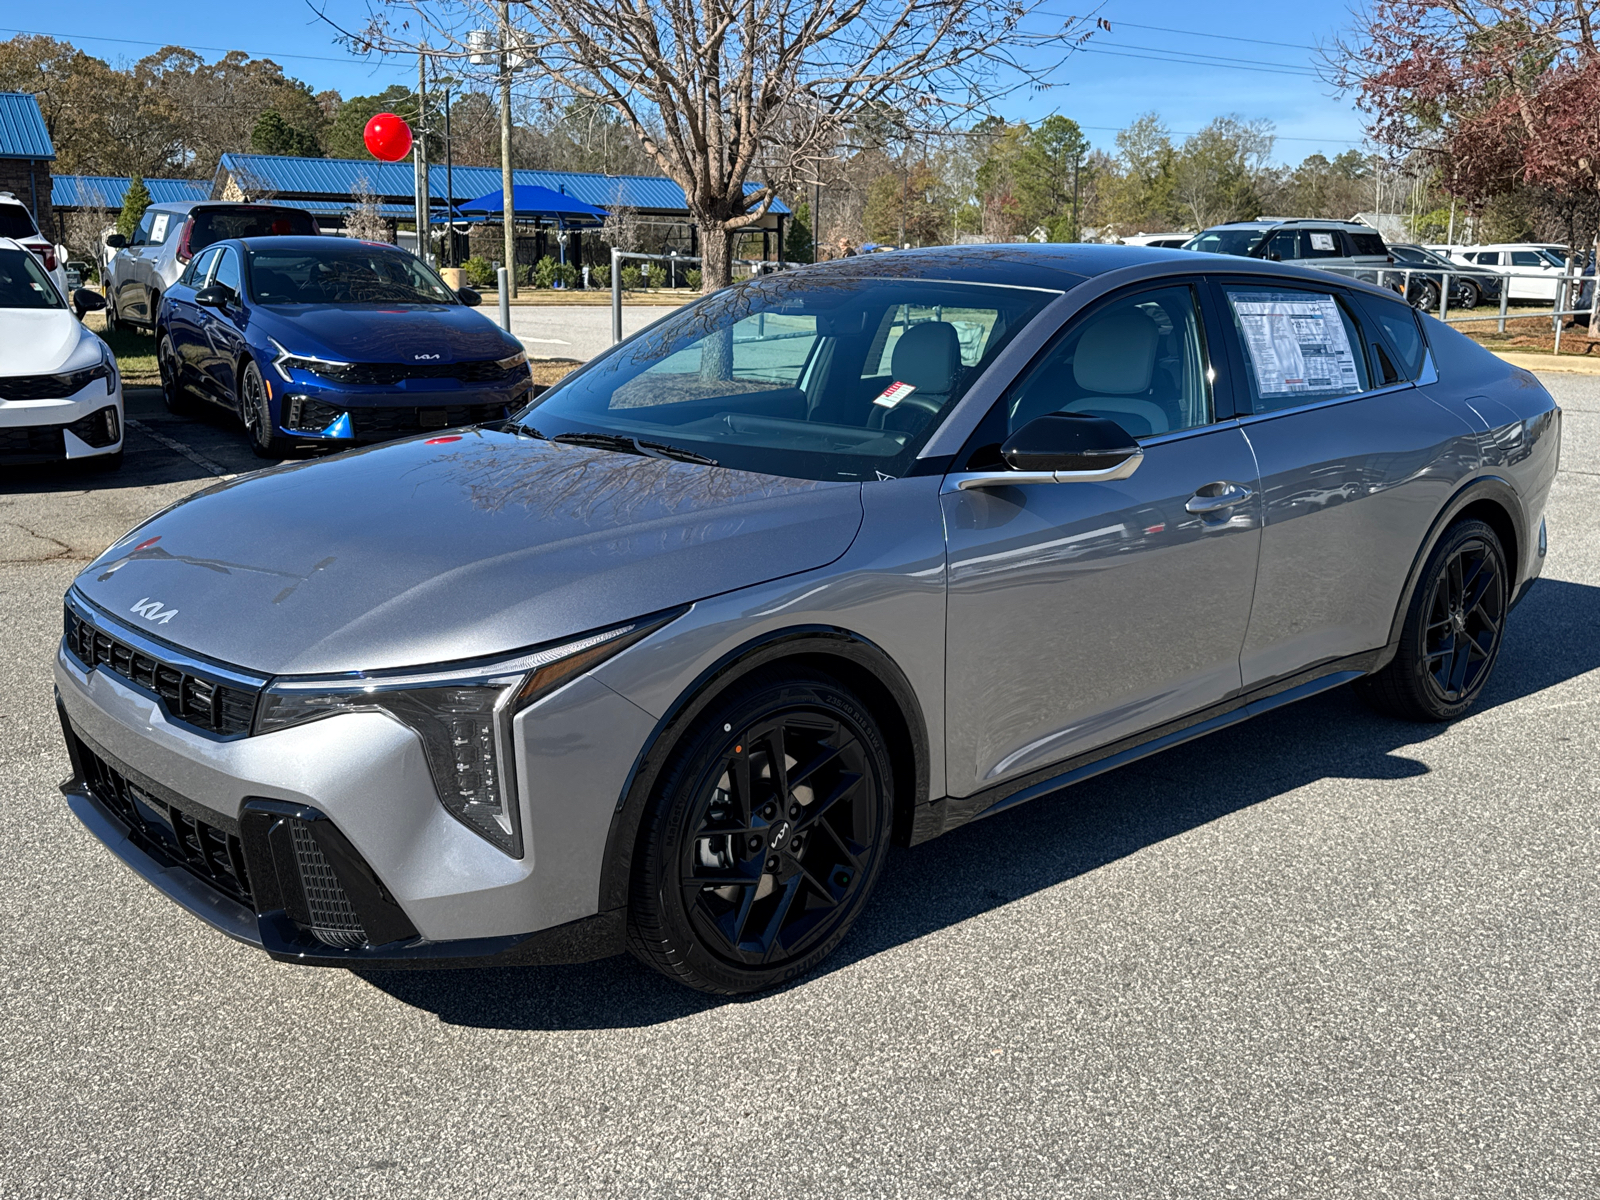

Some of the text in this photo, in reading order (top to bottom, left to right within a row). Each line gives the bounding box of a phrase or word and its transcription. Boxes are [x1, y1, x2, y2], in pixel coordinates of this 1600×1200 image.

[130, 597, 179, 625] KIA
[826, 695, 853, 714] 235/40
[853, 712, 868, 729] R18
[866, 728, 880, 748] 91W
[770, 822, 789, 849] KIA
[784, 932, 841, 980] KUMHO
